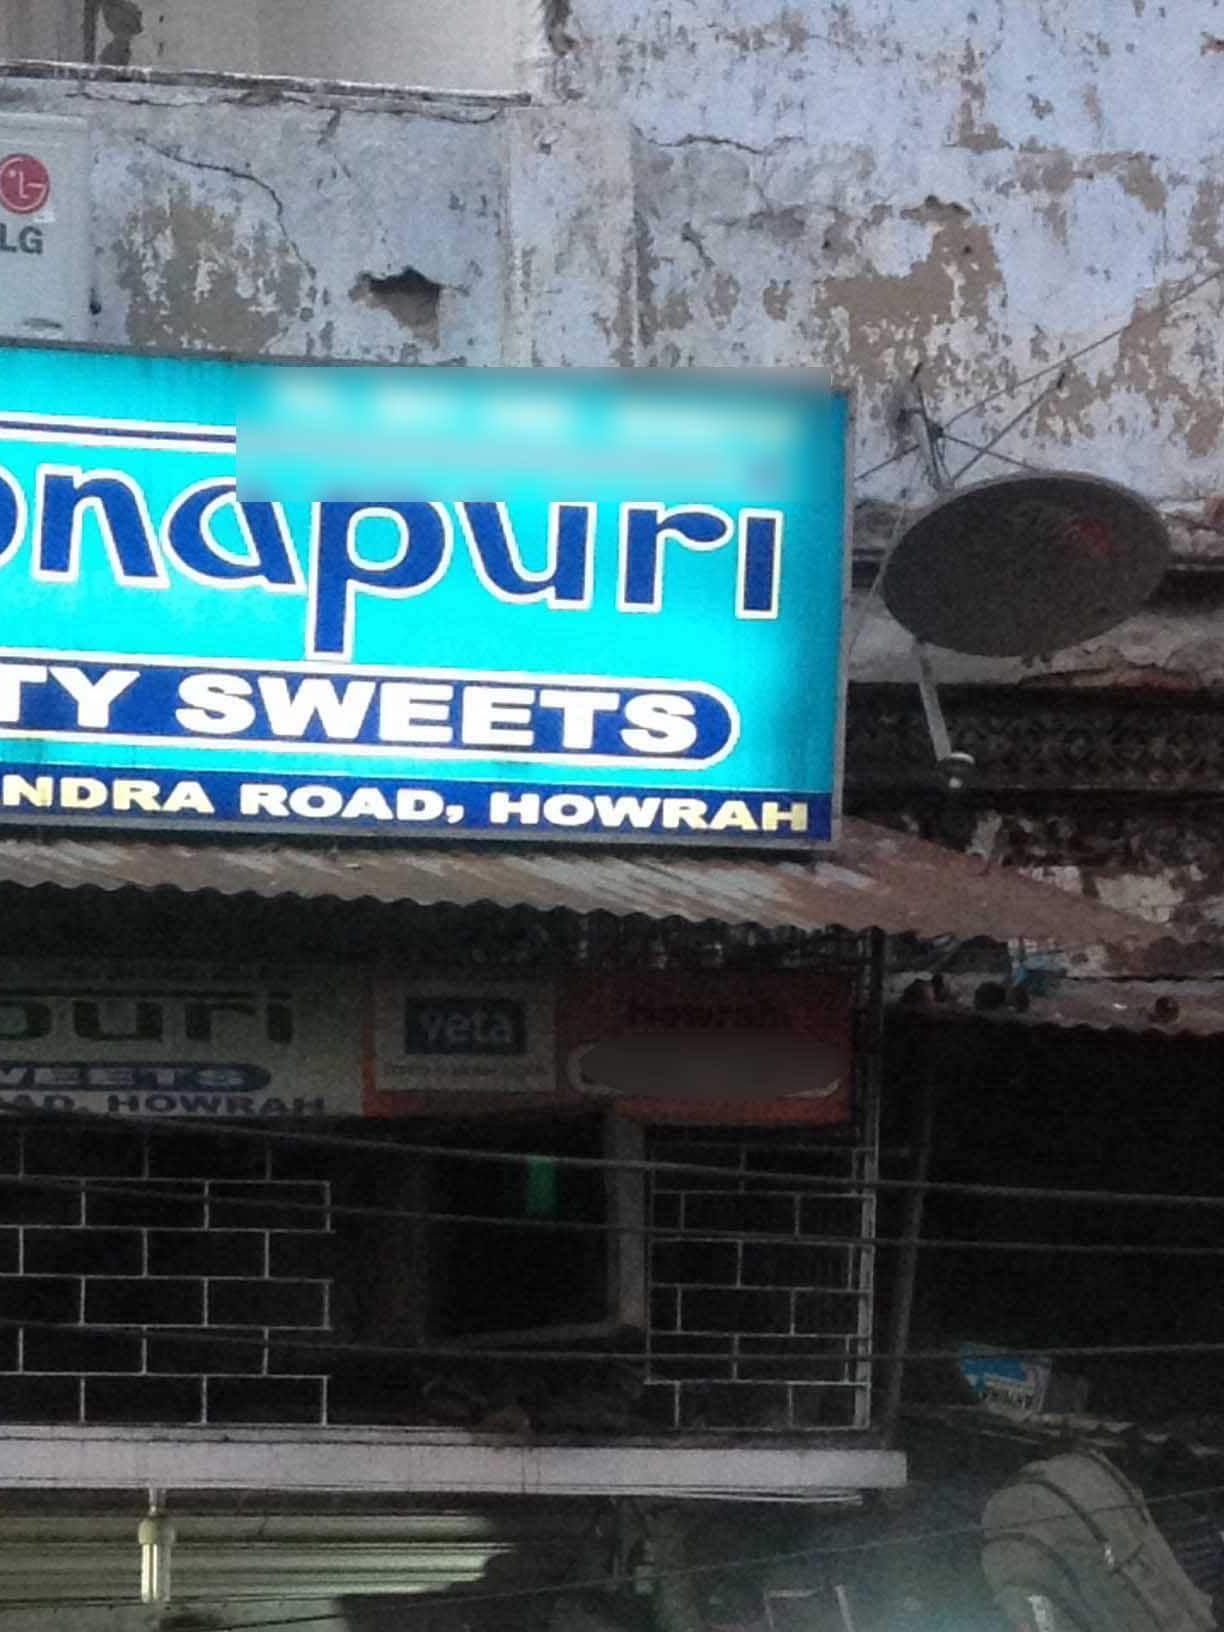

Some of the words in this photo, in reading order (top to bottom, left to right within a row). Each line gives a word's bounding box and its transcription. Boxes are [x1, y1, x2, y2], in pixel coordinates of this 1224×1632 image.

[176, 672, 699, 755] SWEETS
[239, 784, 466, 826] ROAD,
[489, 793, 808, 834] HOWRAH
